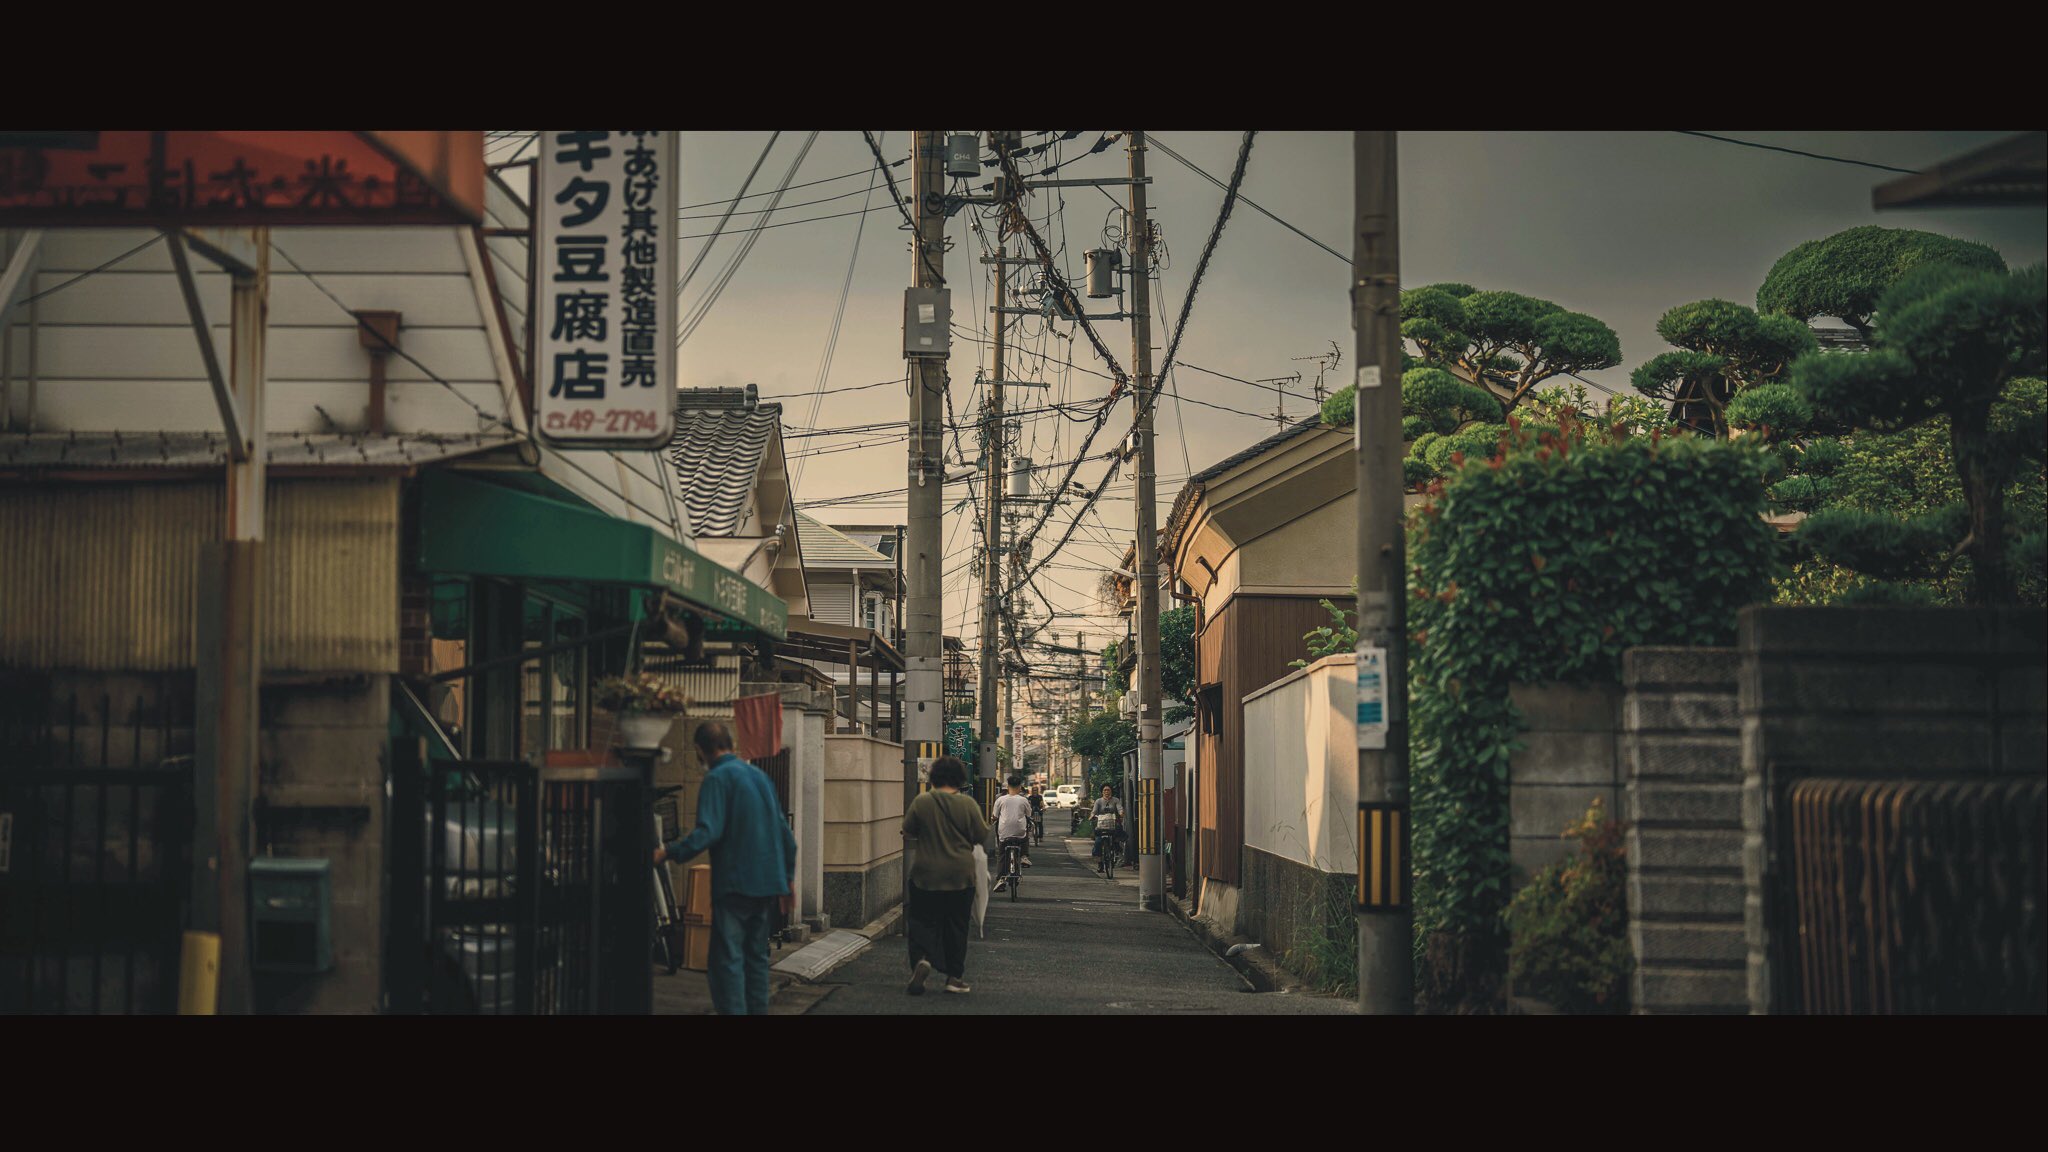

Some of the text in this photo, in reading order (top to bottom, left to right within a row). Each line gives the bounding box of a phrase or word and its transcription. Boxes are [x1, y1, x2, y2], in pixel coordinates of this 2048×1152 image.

[549, 131, 611, 399] キタ豆腐店
[620, 131, 659, 388] ・あげ其他製造直売
[568, 408, 657, 433] 49-2794
